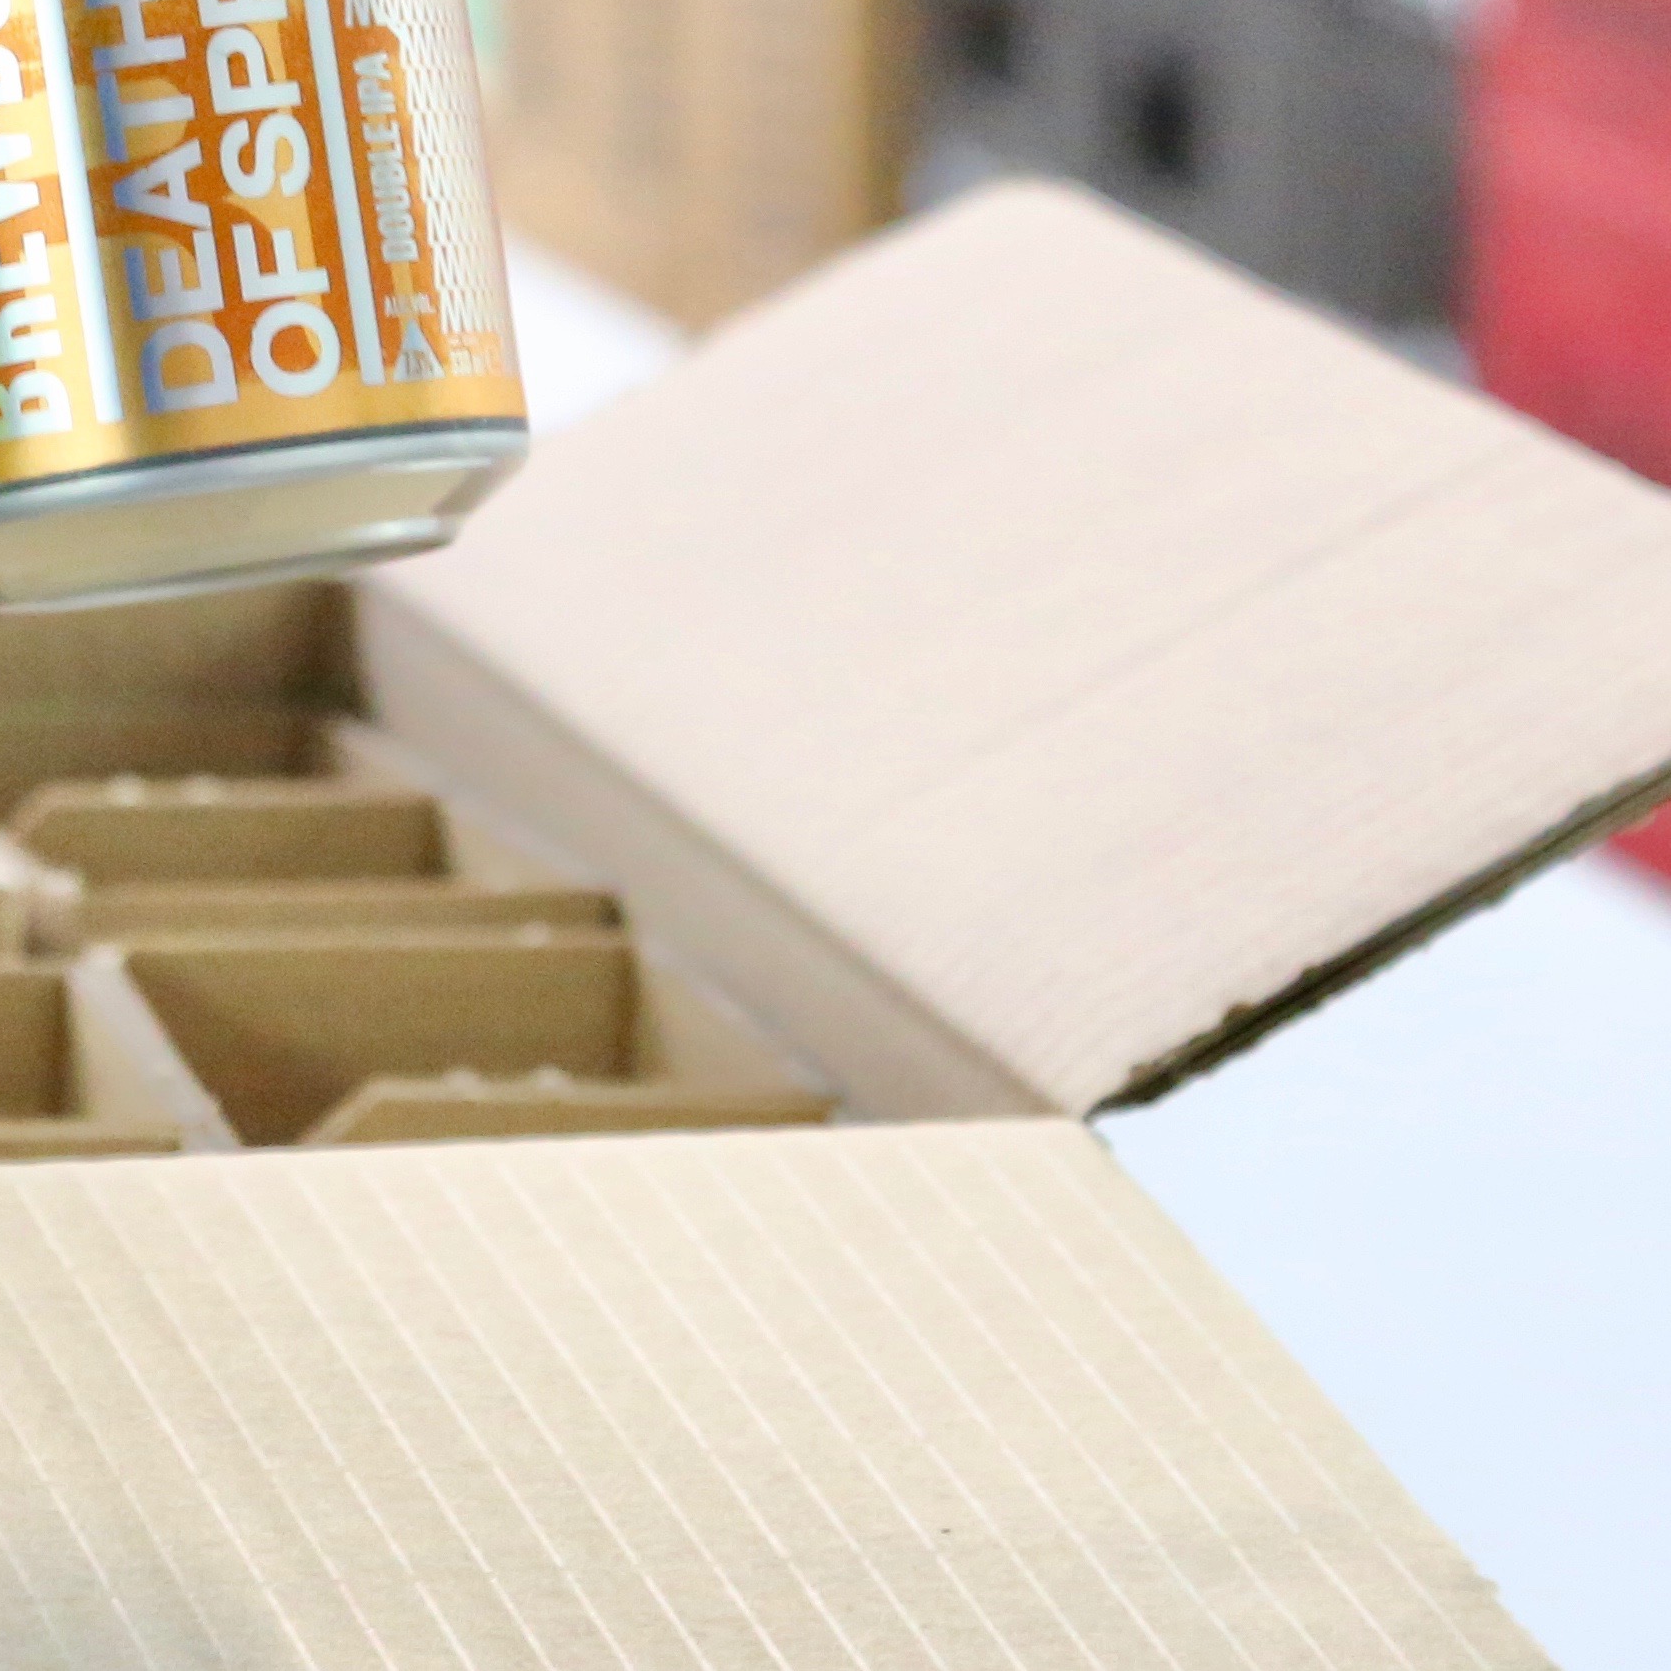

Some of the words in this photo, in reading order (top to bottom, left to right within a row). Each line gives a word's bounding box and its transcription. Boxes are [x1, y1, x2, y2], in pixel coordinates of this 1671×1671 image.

[353, 51, 397, 114] IPA
[361, 120, 420, 264] DOUBLE
[234, 220, 342, 396] OF
